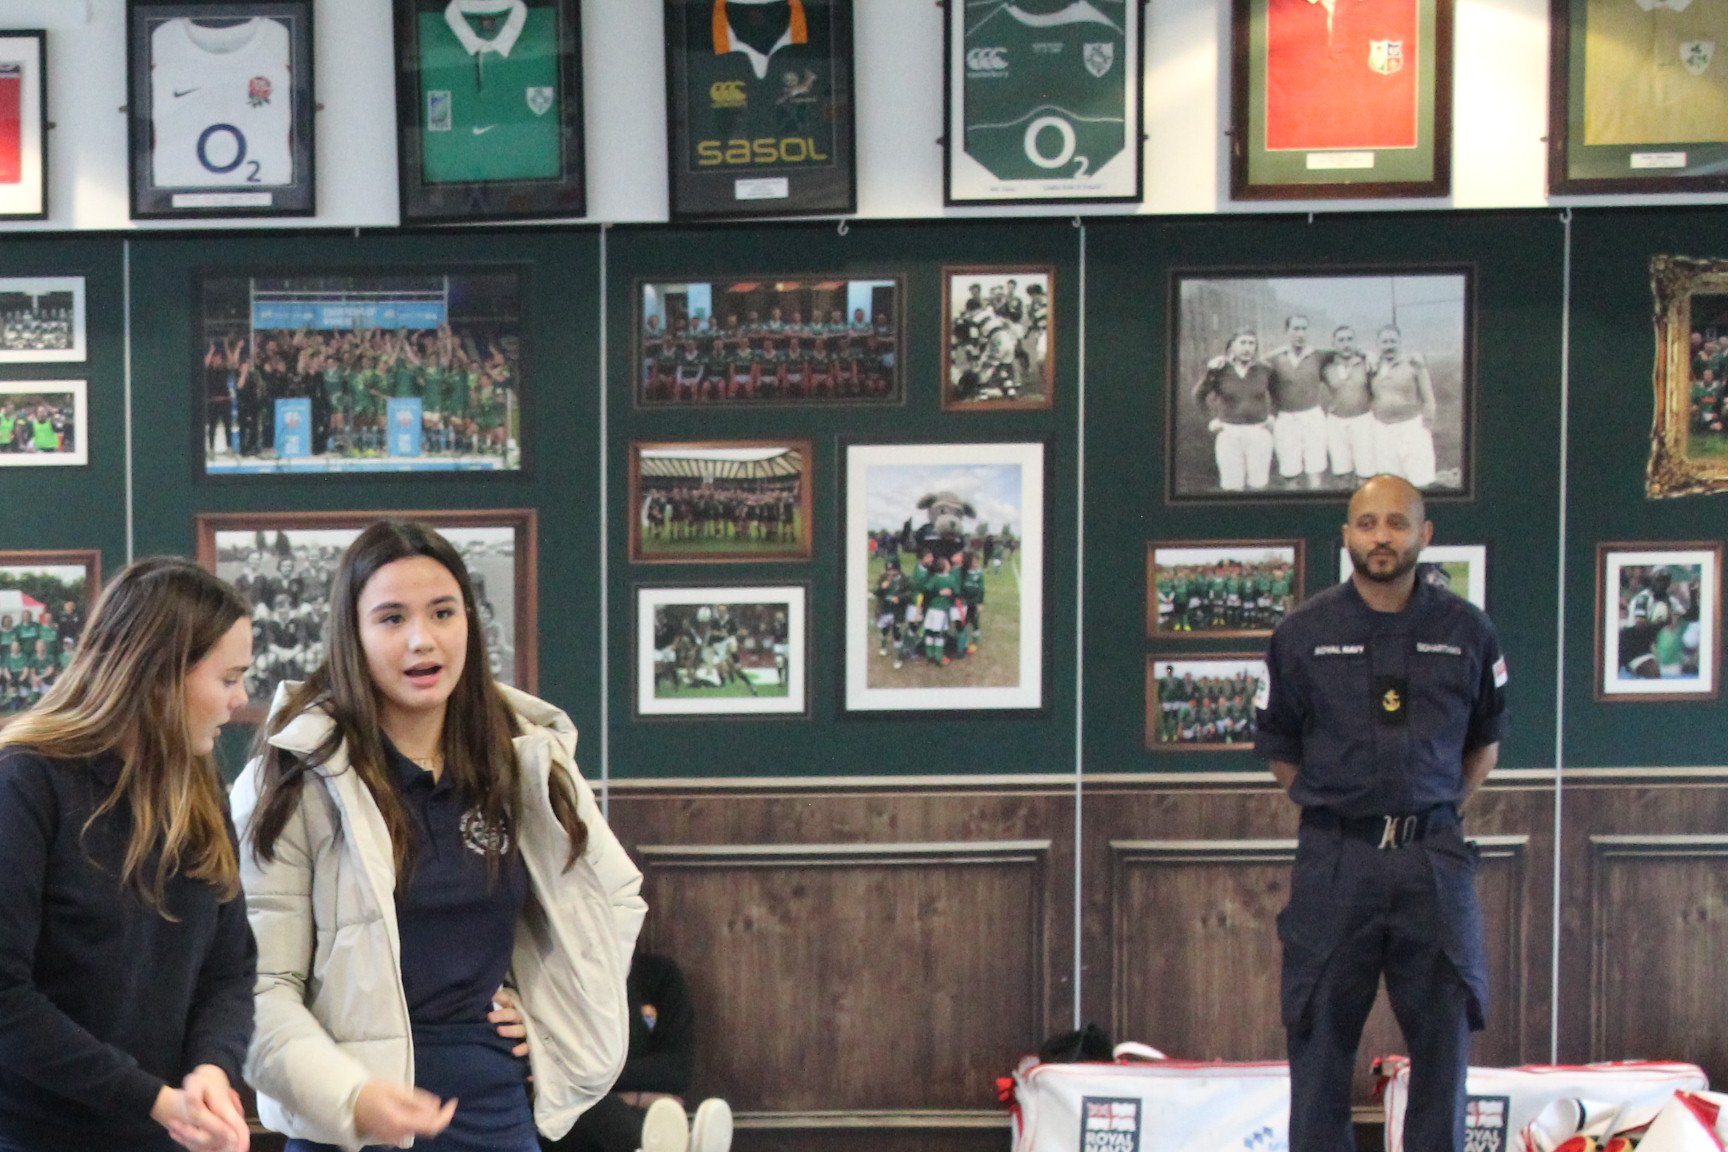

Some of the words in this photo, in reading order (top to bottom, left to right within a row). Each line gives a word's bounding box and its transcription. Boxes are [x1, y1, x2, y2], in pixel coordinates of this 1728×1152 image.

[196, 123, 262, 183] O2
[1024, 116, 1092, 179] O2
[1085, 1131, 1134, 1148] ROYAL
[1464, 1129, 1500, 1143] OYAL
